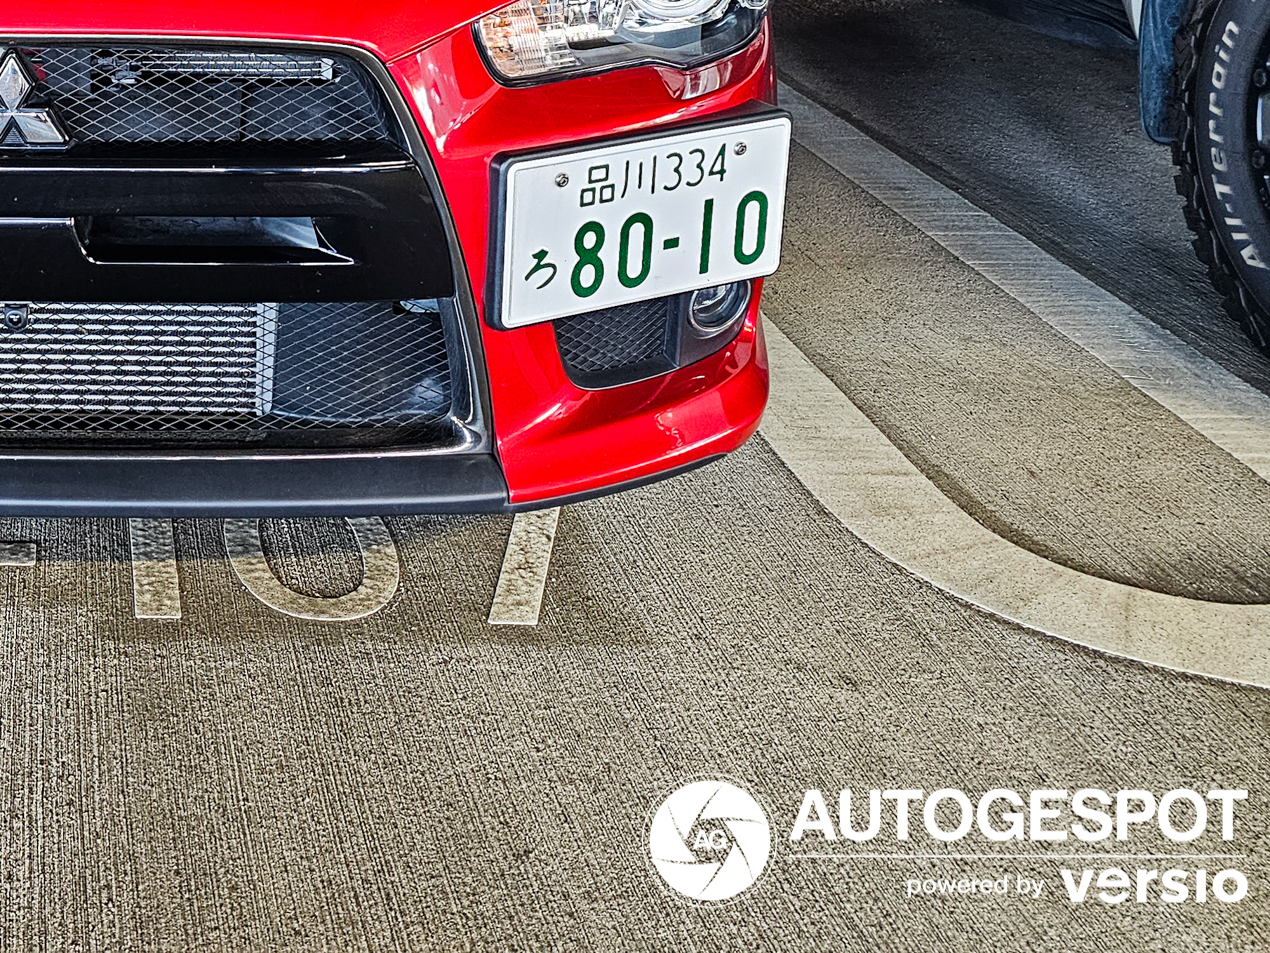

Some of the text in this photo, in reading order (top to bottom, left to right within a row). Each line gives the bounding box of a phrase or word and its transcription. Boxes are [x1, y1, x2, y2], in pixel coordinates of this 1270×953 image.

[1208, 20, 1270, 270] All-Terrain
[524, 190, 769, 298] ろ 80-10
